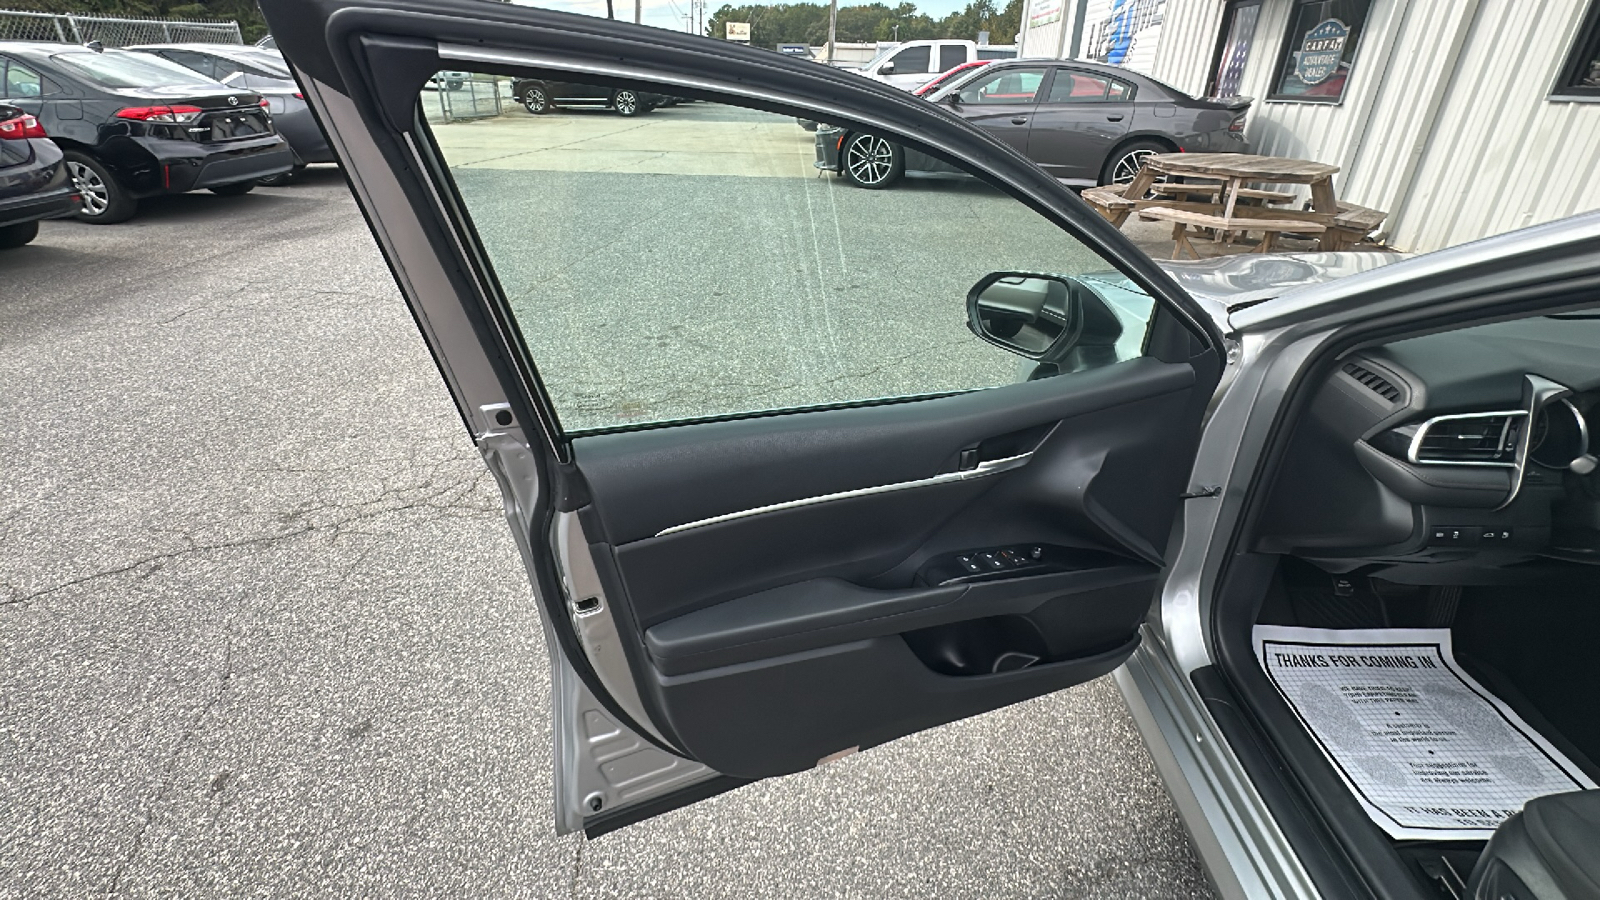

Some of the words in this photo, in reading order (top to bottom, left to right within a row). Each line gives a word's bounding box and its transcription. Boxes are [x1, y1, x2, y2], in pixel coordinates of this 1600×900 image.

[1275, 653, 1328, 668] THANKS
[1328, 655, 1361, 668] FOR
[1360, 656, 1419, 669] COMING
[1417, 656, 1437, 669] IN
[1419, 807, 1452, 816] HAS
[1450, 808, 1492, 818] BEEN
